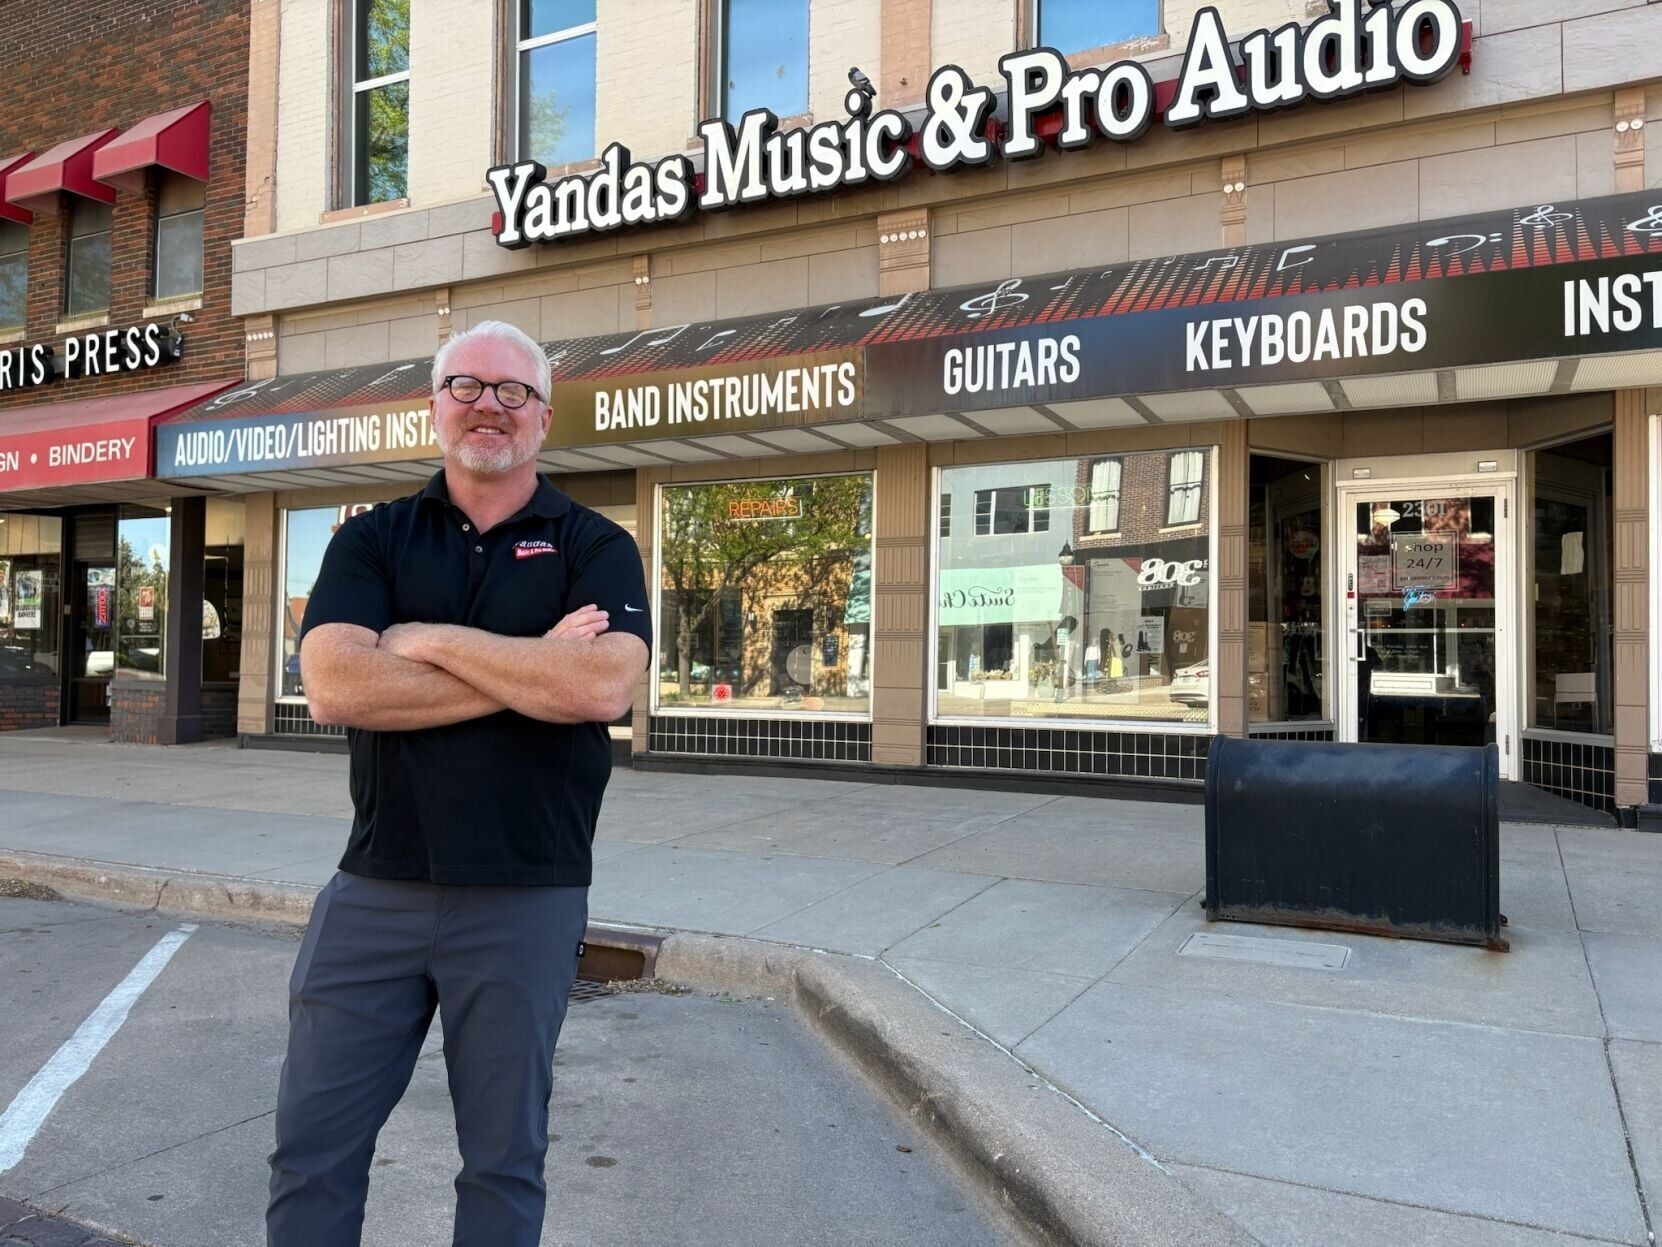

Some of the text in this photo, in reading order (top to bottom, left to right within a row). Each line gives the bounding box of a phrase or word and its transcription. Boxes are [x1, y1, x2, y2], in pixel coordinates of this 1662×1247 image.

[487, 0, 1460, 244] Yandas Music & Pro Audio
[1563, 268, 1662, 337] INST
[0, 322, 160, 390] RIS PRESS
[1184, 297, 1428, 372] KEYBOARDS
[942, 334, 1082, 395] GUITARS
[594, 361, 856, 432] BAND INSTRUMENTS
[49, 437, 136, 467] BINDERY
[174, 414, 381, 467] AUDIO/VIDEO/LIGHTING
[728, 498, 799, 518] REPAIRS
[1402, 501, 1447, 518] 2301
[1405, 543, 1444, 554] shop
[1406, 557, 1443, 570] 24/7
